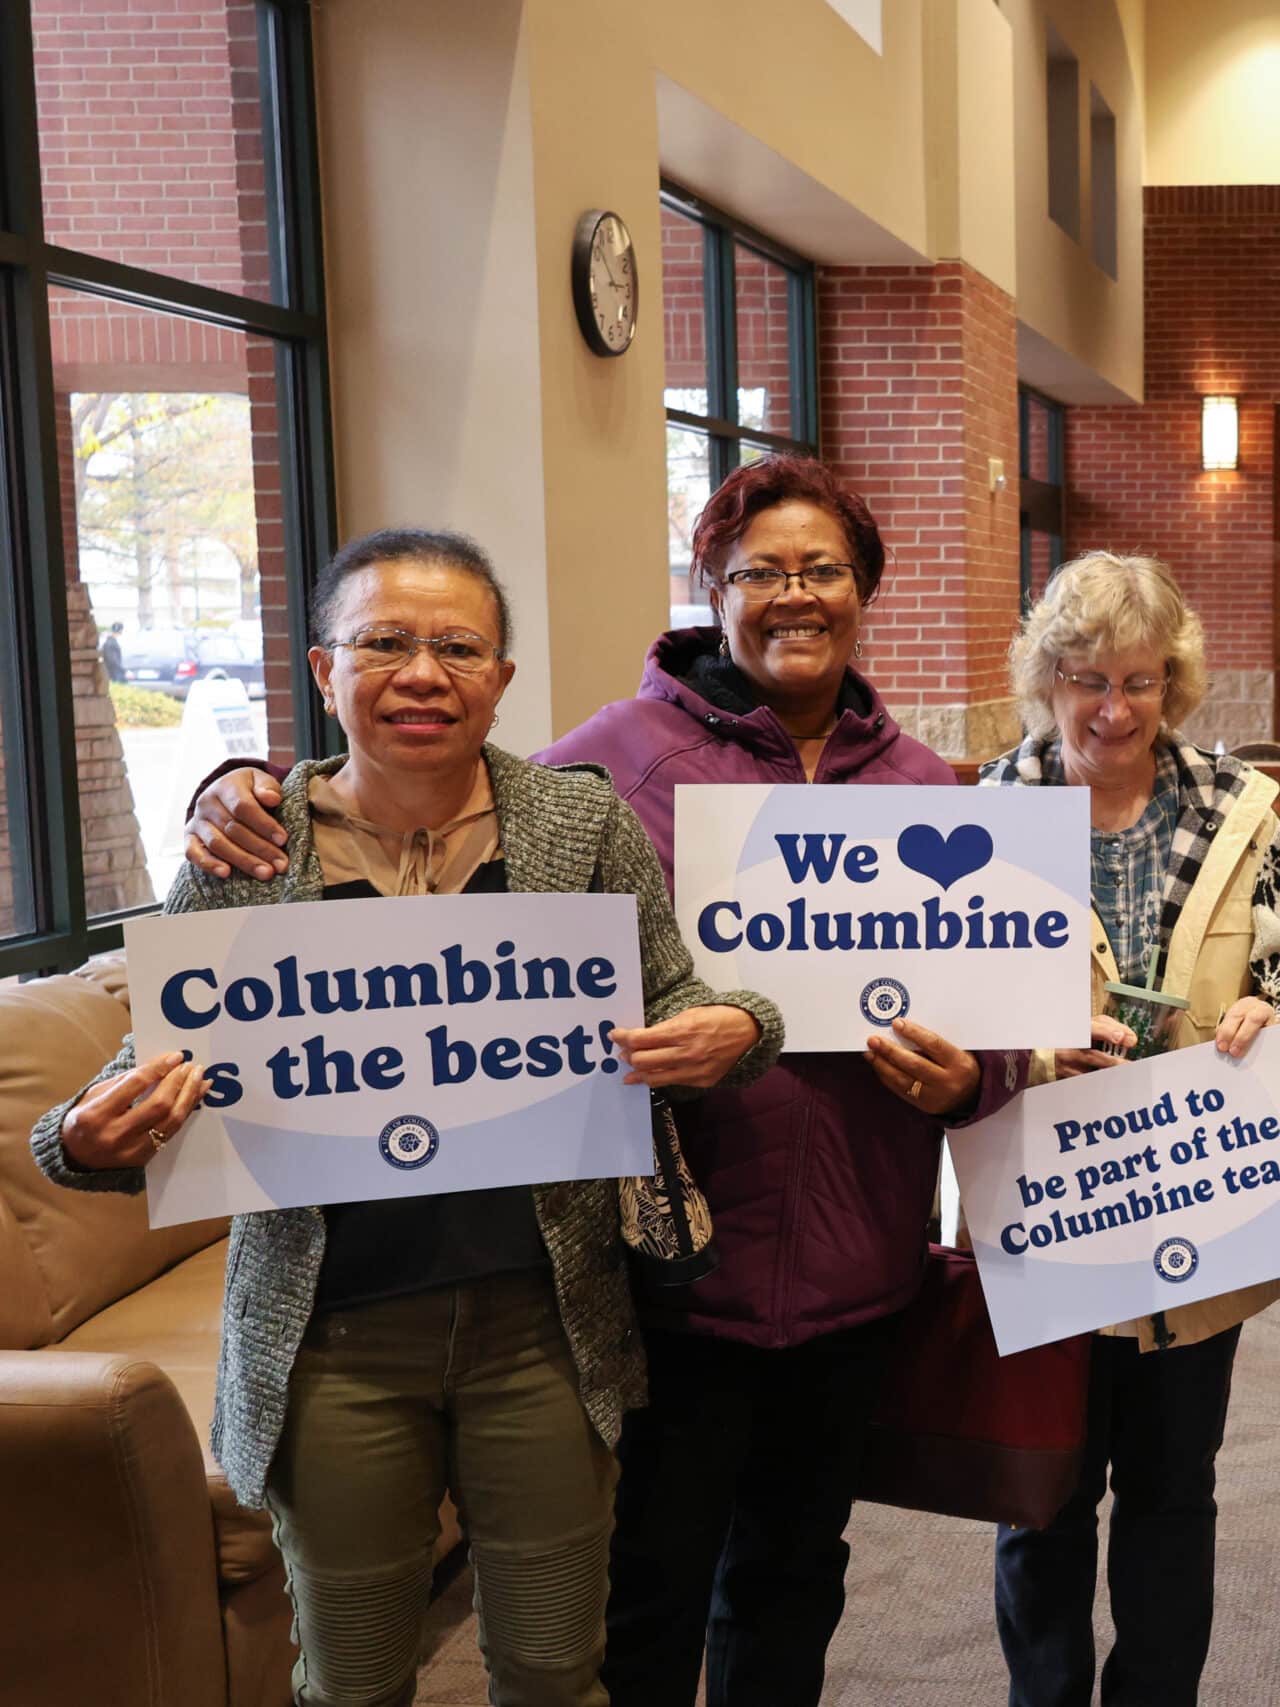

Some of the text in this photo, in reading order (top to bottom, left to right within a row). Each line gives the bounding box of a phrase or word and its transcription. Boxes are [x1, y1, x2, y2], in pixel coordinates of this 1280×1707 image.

[622, 256, 630, 275] 2
[625, 282, 631, 300] 3
[599, 313, 606, 331] 7
[608, 324, 615, 342] 6
[616, 320, 624, 337] 5
[774, 834, 879, 884] We
[699, 895, 1069, 953] Columbine
[161, 940, 617, 1030] Columbine
[179, 1019, 620, 1112] s the best!
[1055, 1089, 1225, 1153] Proud to
[1018, 1116, 1280, 1207] be part of the
[1001, 1178, 1215, 1256] Columbine
